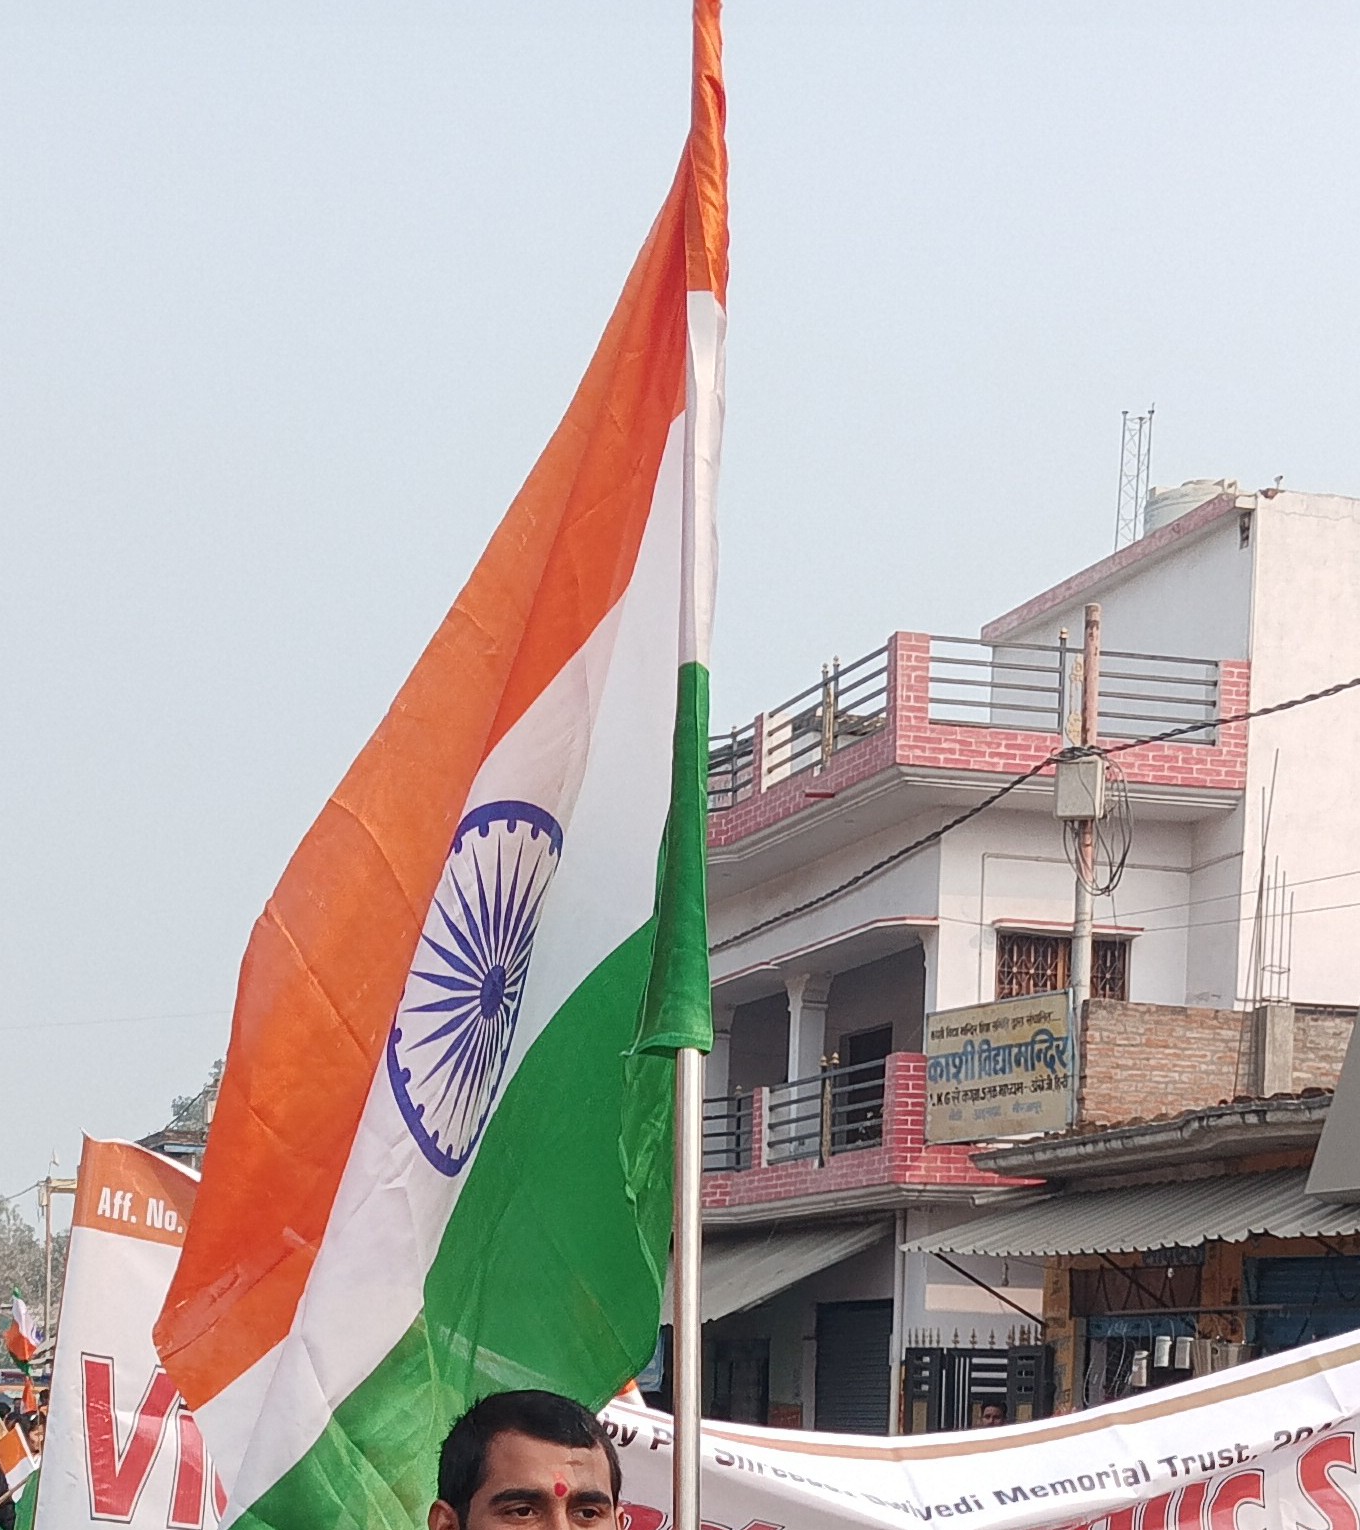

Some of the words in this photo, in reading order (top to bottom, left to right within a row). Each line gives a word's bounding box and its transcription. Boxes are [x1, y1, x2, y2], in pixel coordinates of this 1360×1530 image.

[928, 1039, 975, 1084] काशी
[978, 1038, 1014, 1080] विद्या
[1014, 1028, 1069, 1074] मन्दिर
[97, 1187, 138, 1224] Aff.
[146, 1198, 184, 1233] No.
[80, 1350, 228, 1530] Vi
[993, 1459, 1152, 1506] Memorial
